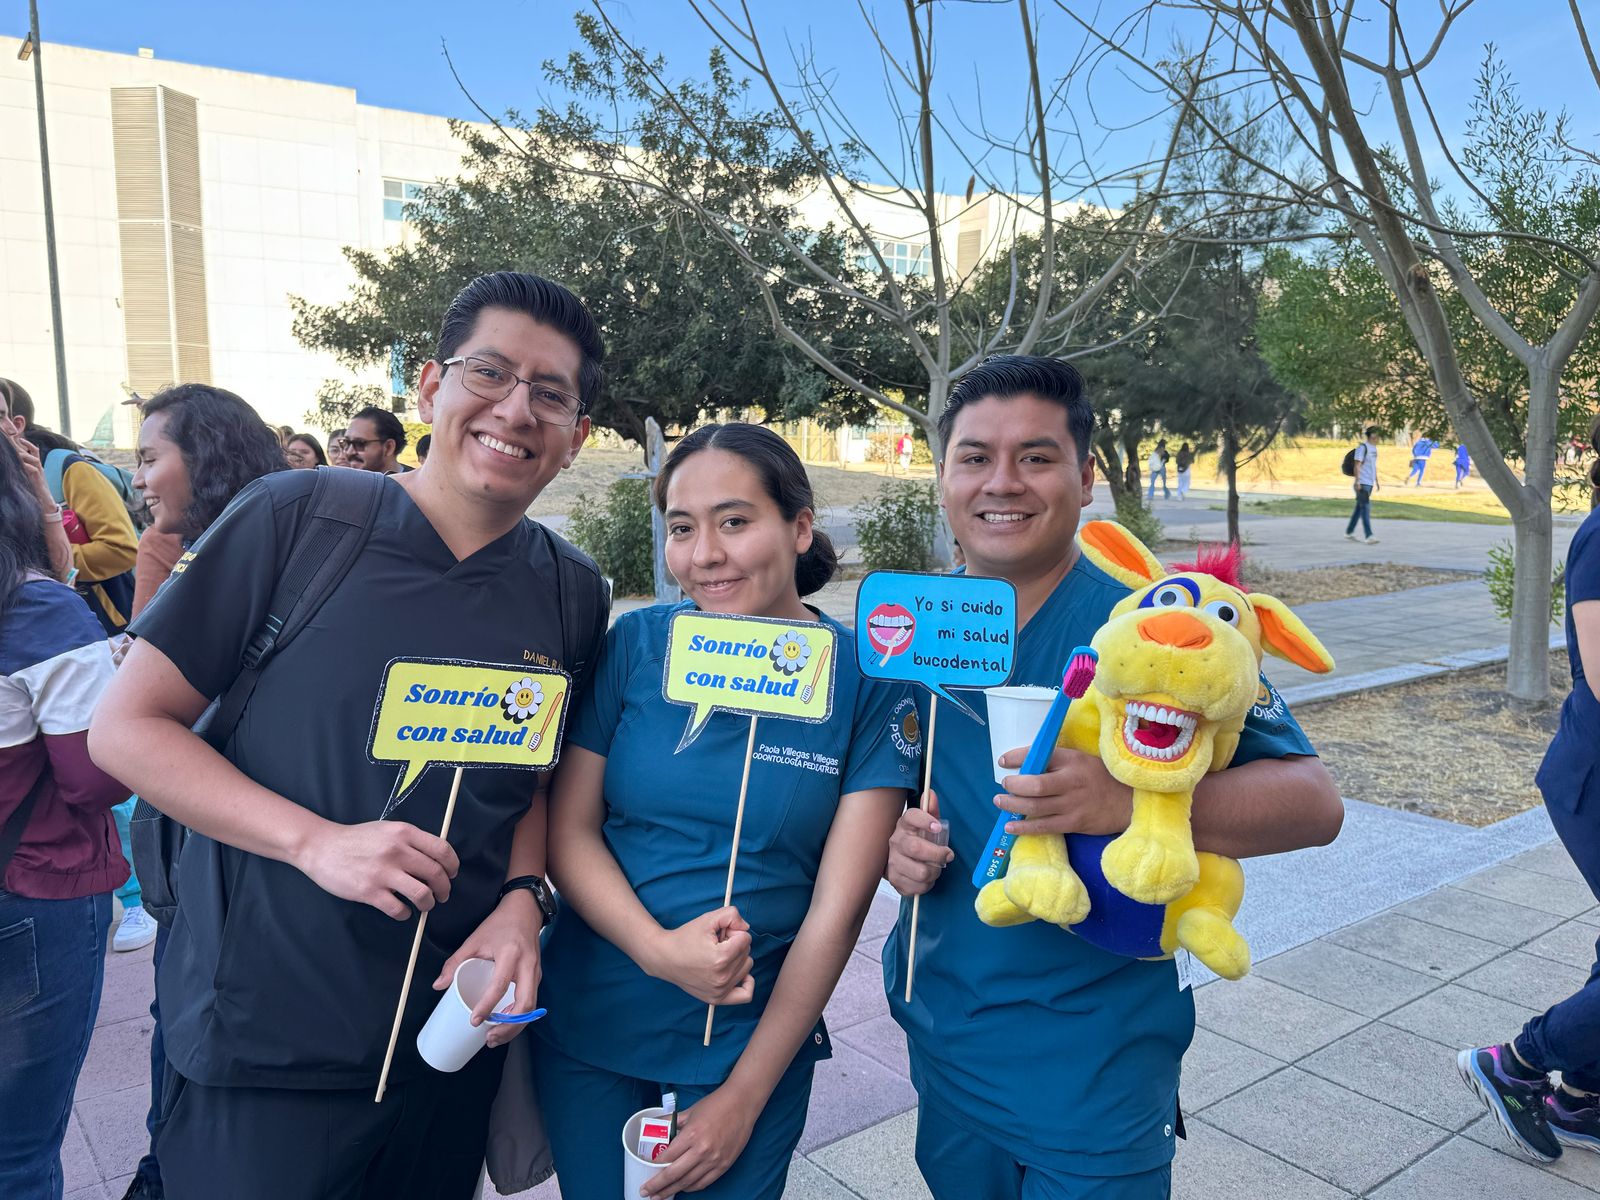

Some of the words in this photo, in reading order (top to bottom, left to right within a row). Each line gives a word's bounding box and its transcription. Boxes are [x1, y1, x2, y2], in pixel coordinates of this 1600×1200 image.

[915, 596, 933, 612] Yo
[941, 600, 953, 612] si
[961, 600, 1003, 616] cuido
[688, 634, 768, 659] Sonrío
[937, 628, 955, 639] mi
[963, 628, 1009, 645] salud
[523, 649, 551, 668] DANIEL
[913, 652, 1008, 673] bucodental
[685, 671, 726, 689] con
[730, 675, 799, 697] salud
[404, 684, 499, 708] Sonrío
[396, 725, 446, 742] con
[451, 725, 529, 746] salud
[759, 744, 780, 754] Paola
[782, 747, 810, 760] Villegas
[812, 753, 839, 766] Villegas
